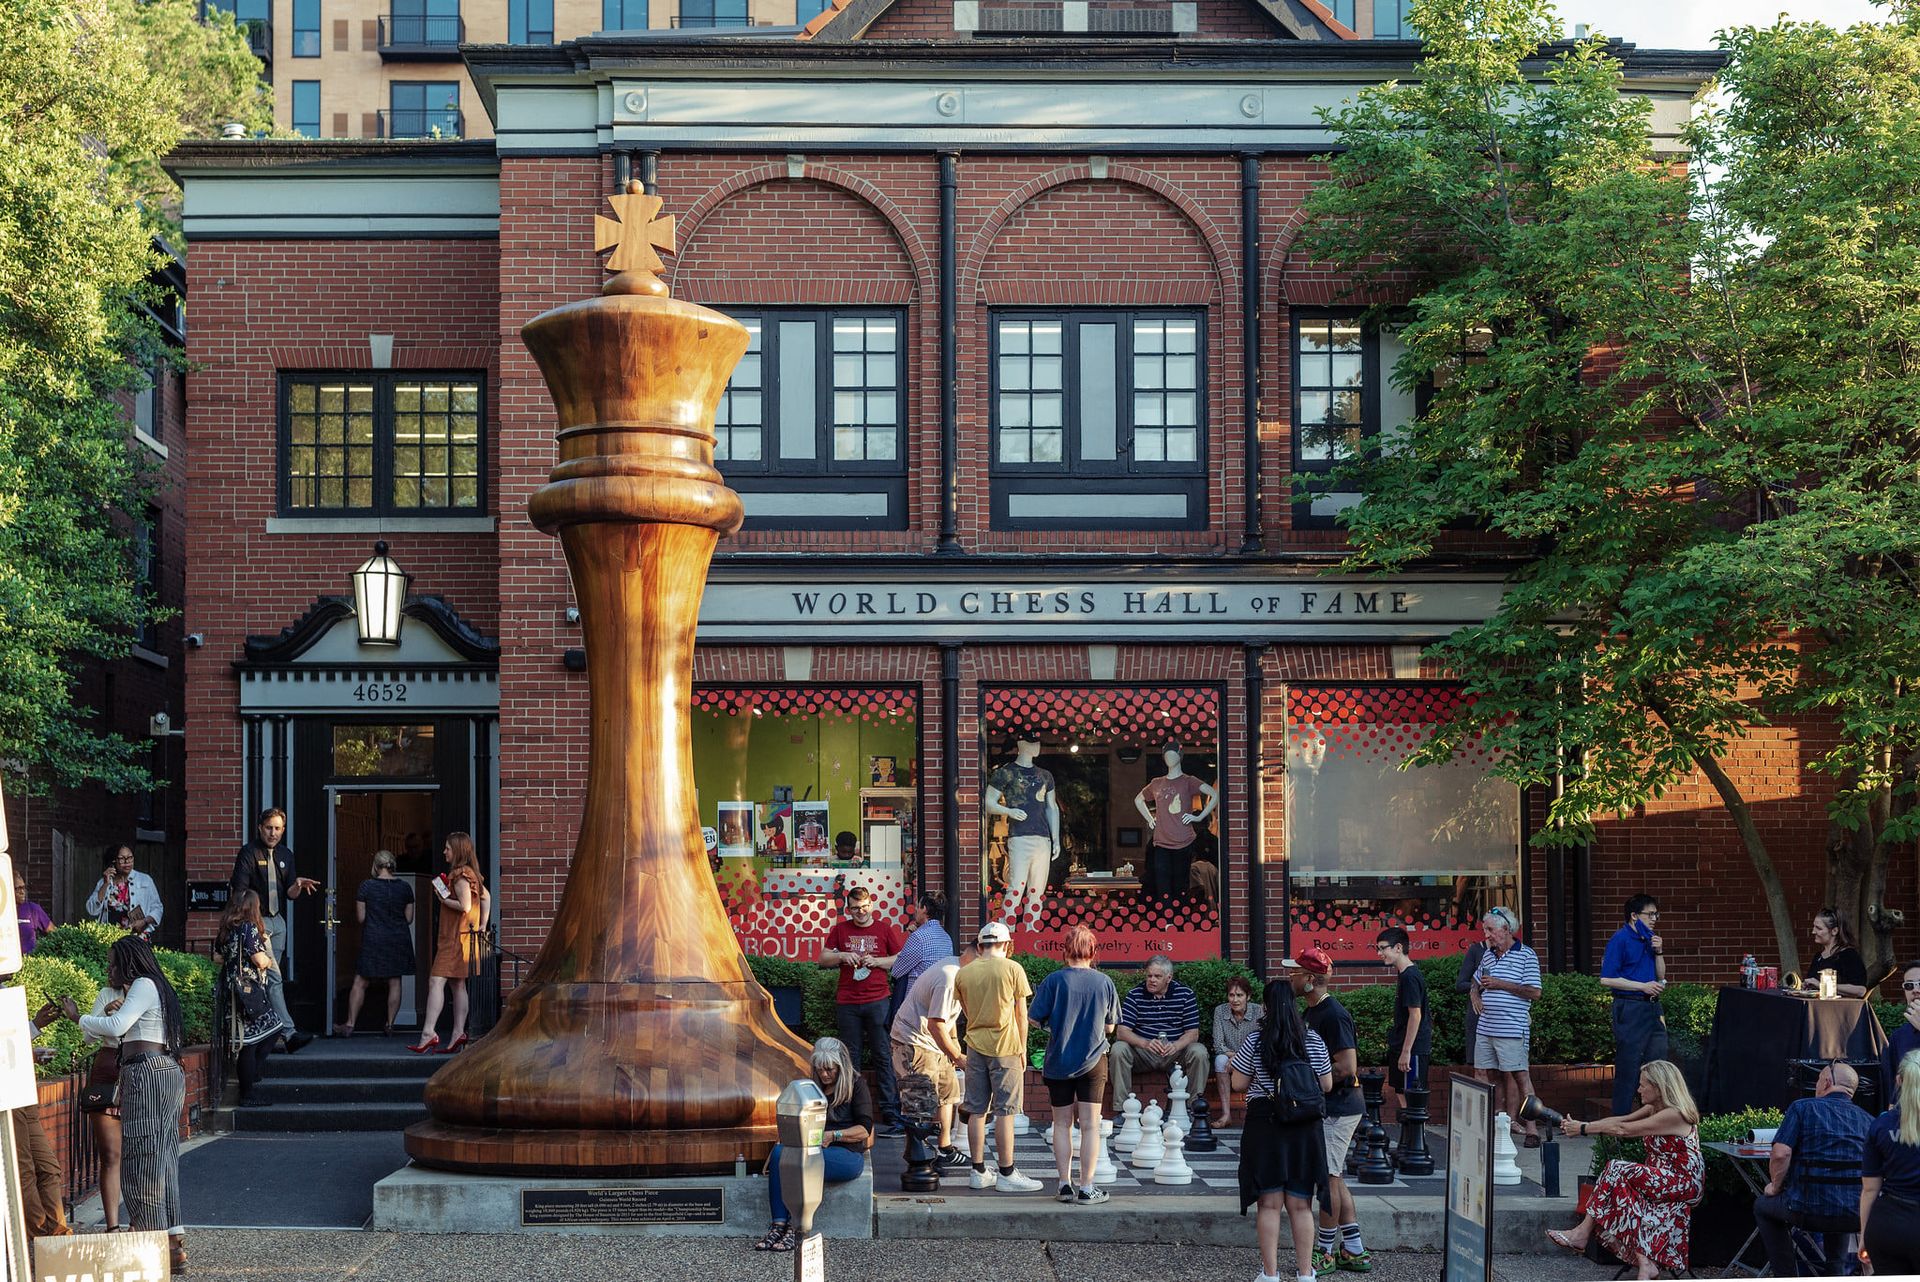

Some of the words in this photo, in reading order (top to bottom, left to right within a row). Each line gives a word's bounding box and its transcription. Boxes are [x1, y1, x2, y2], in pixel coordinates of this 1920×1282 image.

[792, 592, 937, 614] WORLD
[959, 592, 1095, 614] CHESS
[1123, 592, 1227, 613] HALL
[1300, 592, 1409, 613] FAME
[353, 683, 407, 701] 4652
[1145, 940, 1173, 951] Kids
